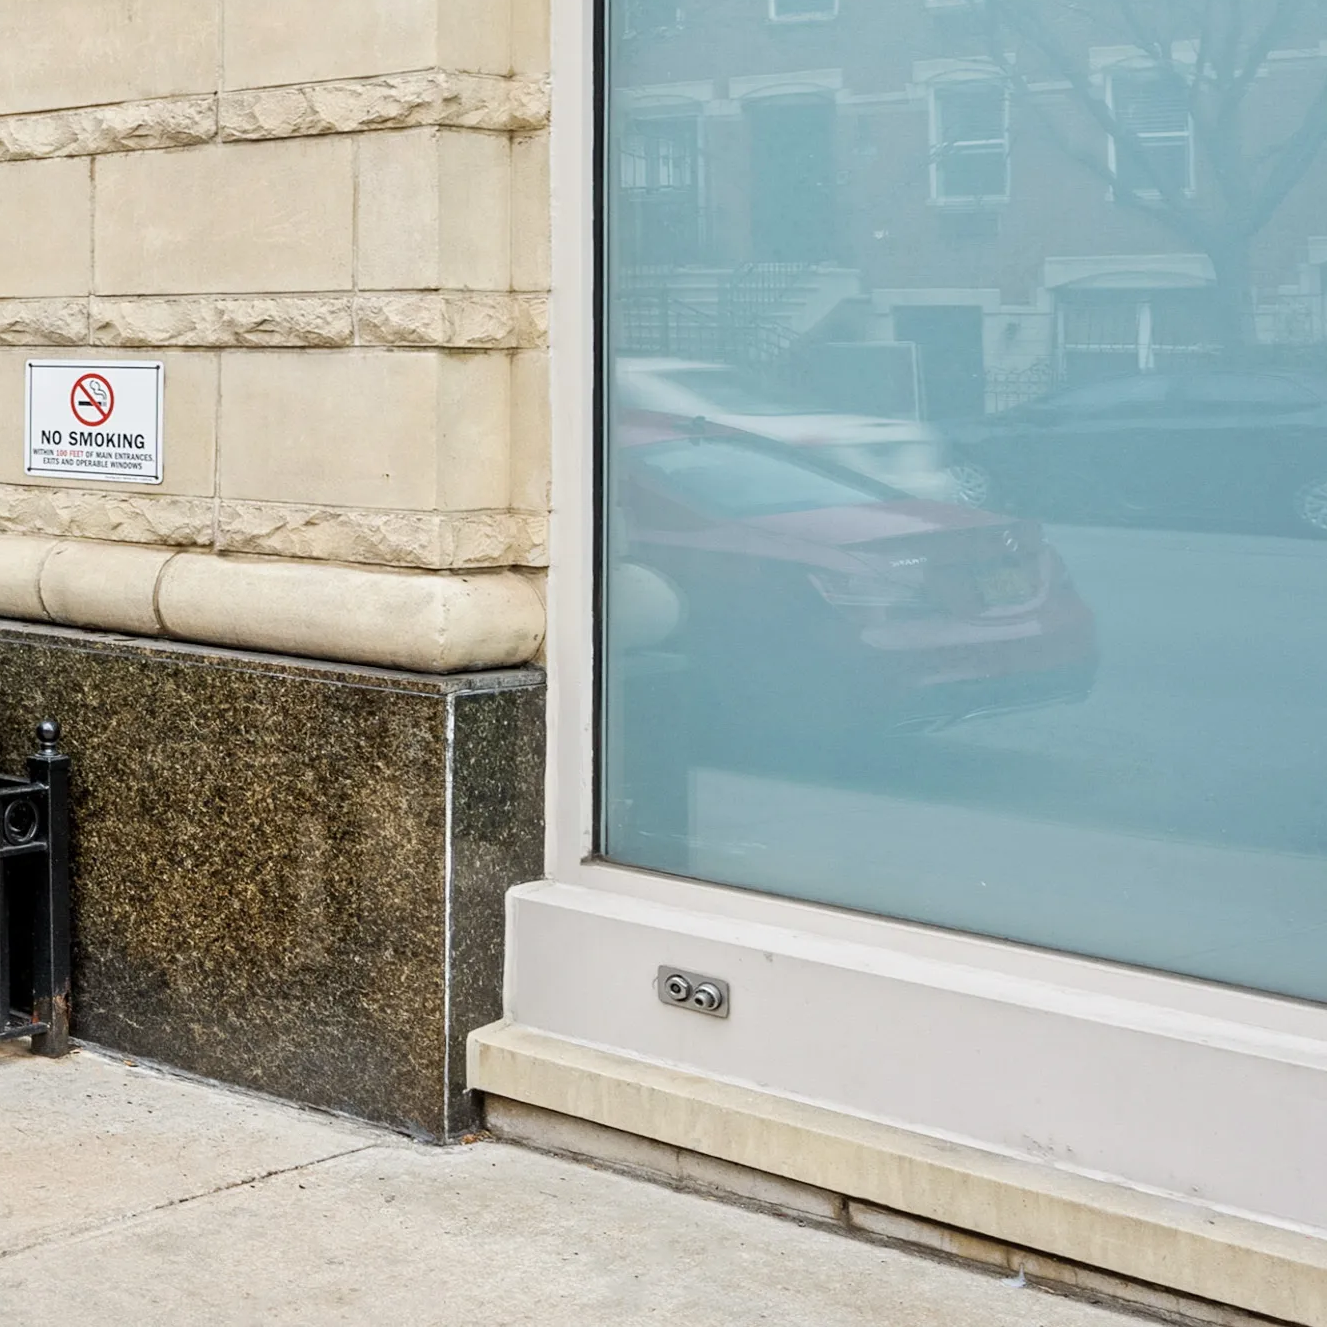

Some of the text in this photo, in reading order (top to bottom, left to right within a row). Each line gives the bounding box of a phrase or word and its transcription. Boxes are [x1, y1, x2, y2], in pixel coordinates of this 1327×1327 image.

[41, 430, 145, 449] NO SMOKING
[56, 449, 68, 457] 100
[96, 451, 112, 459] MAIN
[43, 457, 143, 470] EXITS AND OPERABLE WINDOWS
